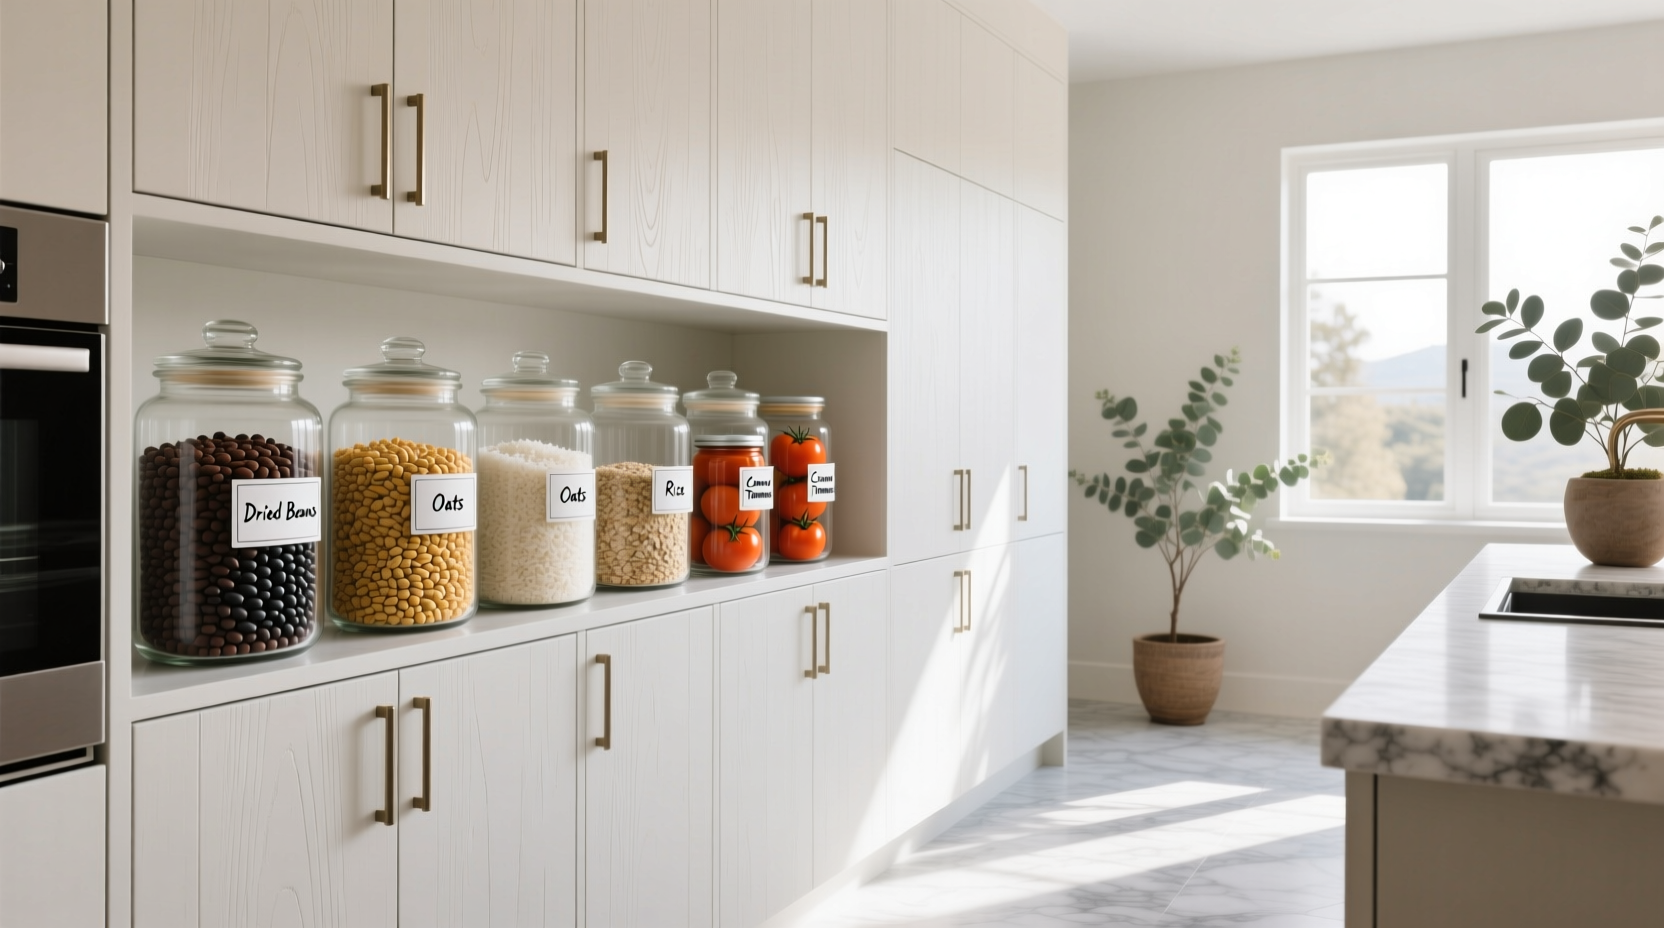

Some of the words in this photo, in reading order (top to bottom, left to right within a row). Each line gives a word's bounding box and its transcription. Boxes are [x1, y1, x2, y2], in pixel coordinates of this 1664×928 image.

[432, 493, 464, 512] Oats
[560, 486, 587, 503] Oats
[244, 501, 282, 523] Dried
